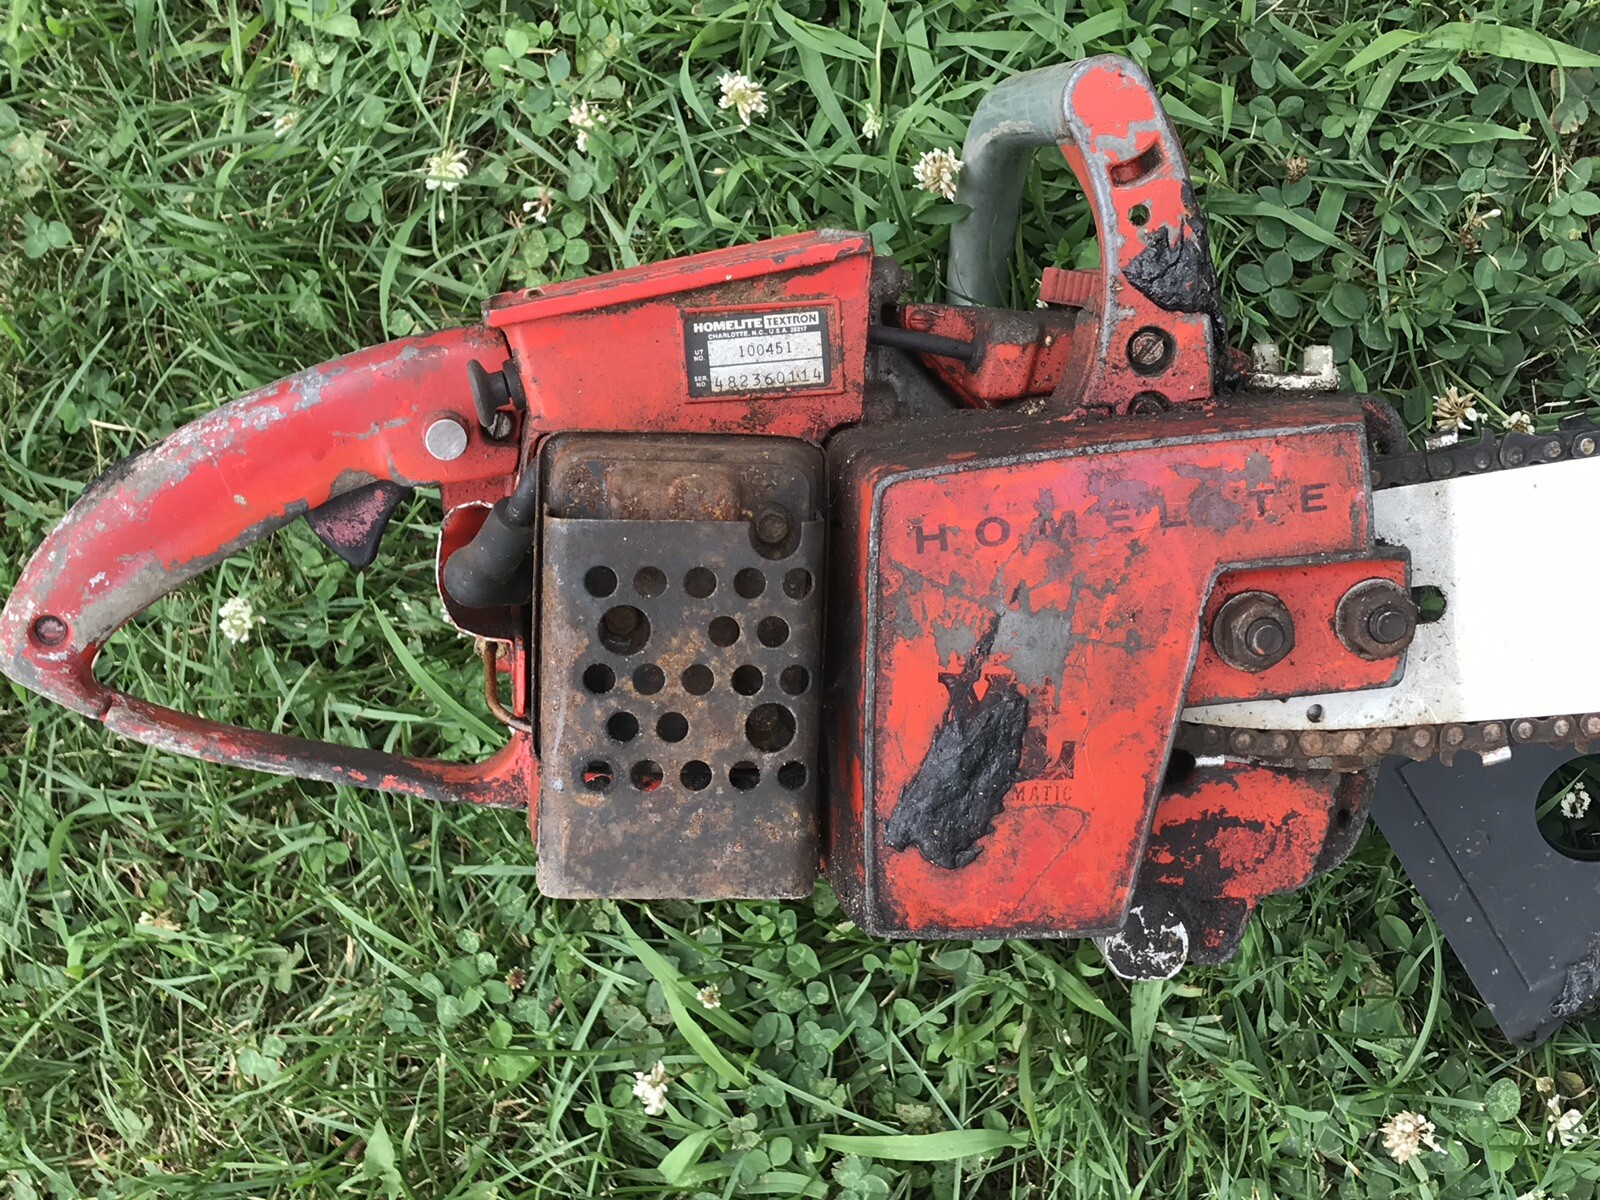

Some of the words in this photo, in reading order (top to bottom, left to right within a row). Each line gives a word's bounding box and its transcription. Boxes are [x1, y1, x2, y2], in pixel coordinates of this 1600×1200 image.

[693, 318, 763, 333] HOMELITE
[766, 314, 817, 326] TEXTRON
[739, 341, 792, 358] 100451
[715, 368, 821, 389] 482360114
[915, 482, 1328, 554] HOMELTE
